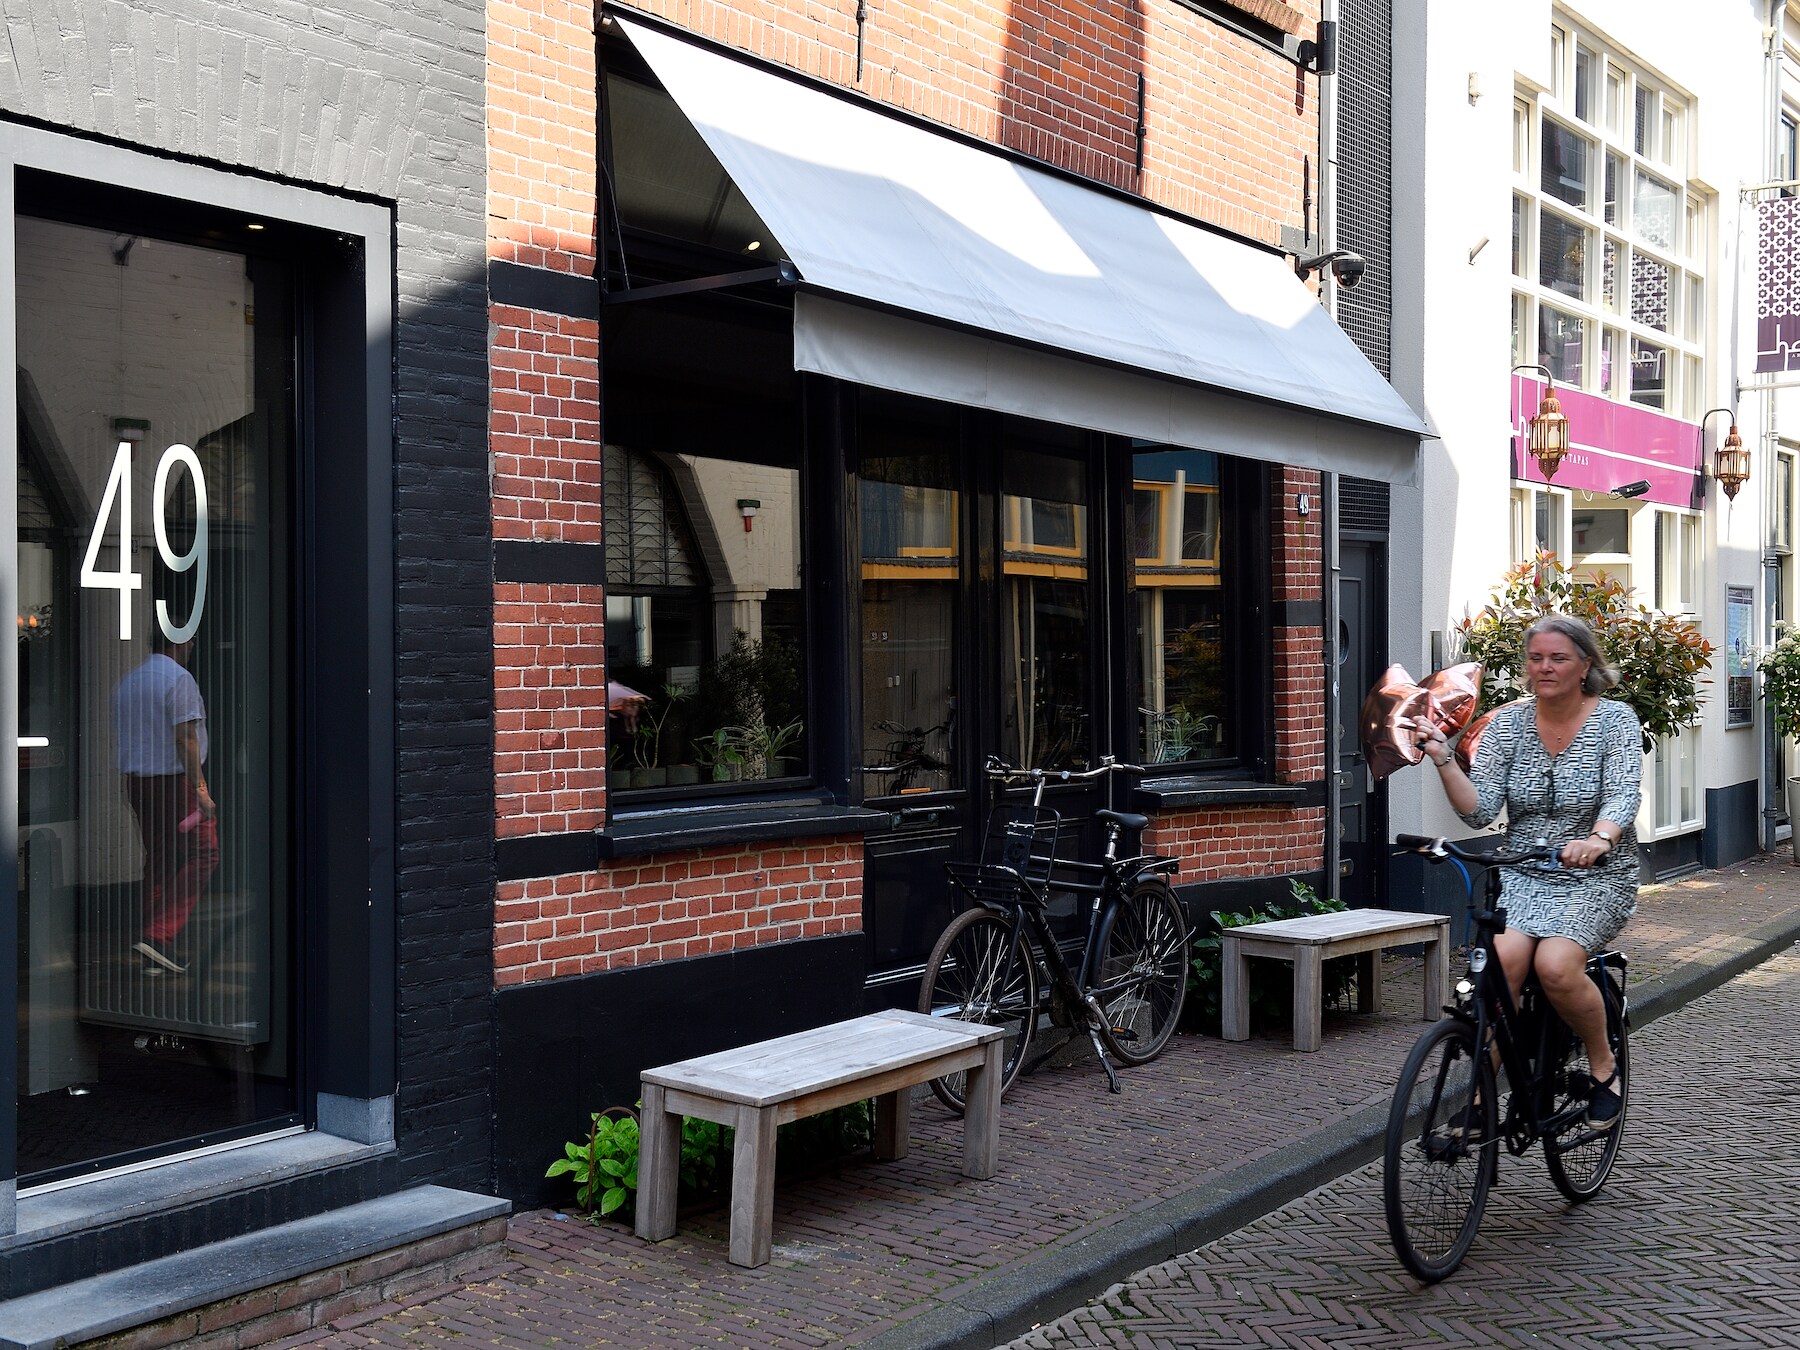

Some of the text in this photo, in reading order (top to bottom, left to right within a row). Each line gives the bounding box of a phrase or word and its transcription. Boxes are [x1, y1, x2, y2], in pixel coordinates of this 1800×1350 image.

[1568, 453, 1589, 466] TAPAS
[1299, 494, 1309, 513] 49
[80, 441, 209, 644] 49
